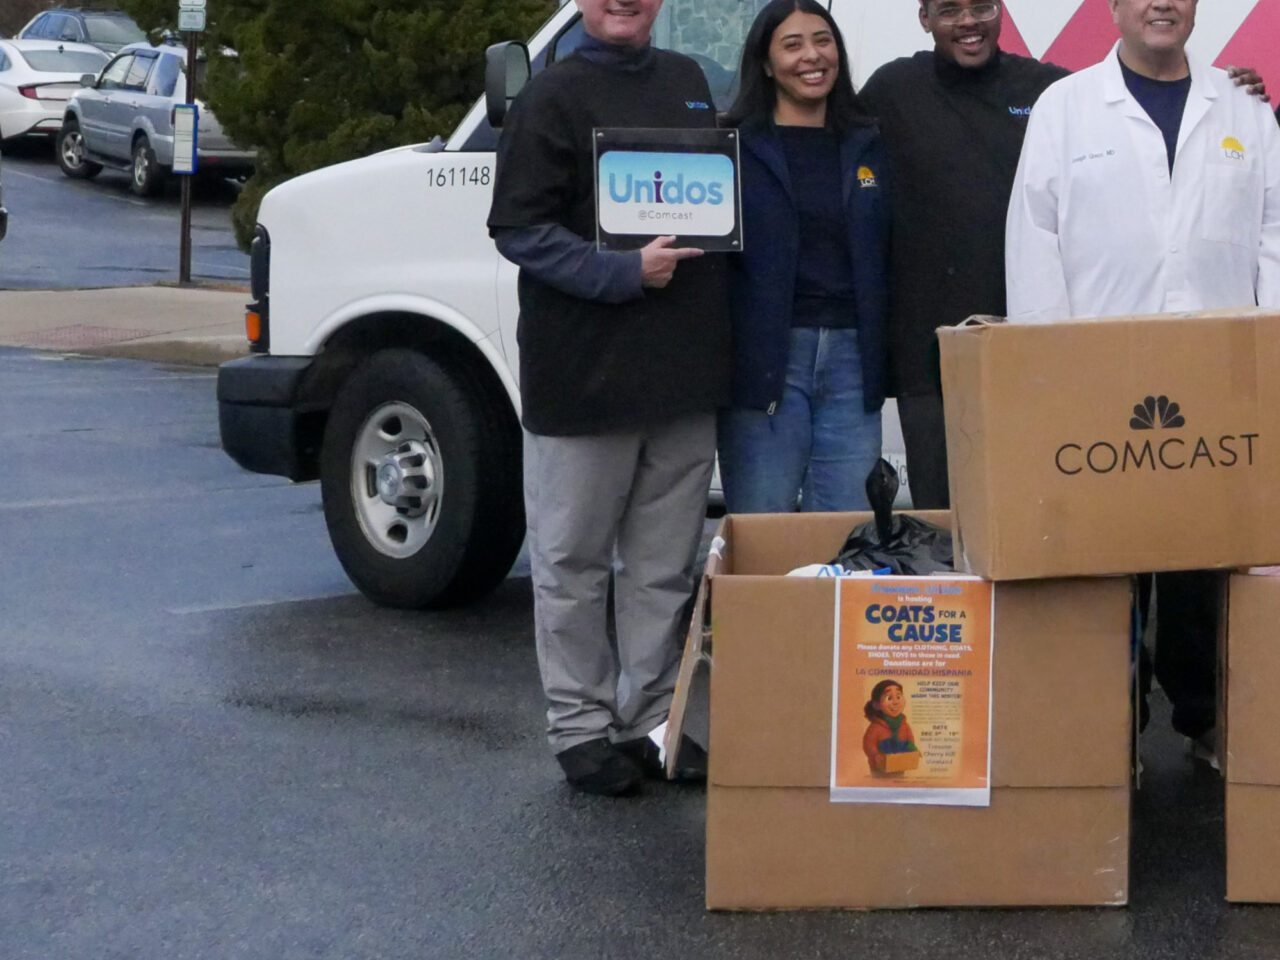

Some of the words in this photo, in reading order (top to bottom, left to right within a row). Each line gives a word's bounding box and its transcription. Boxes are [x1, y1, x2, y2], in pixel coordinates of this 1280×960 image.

[427, 166, 490, 187] 161148
[608, 170, 724, 205] Unidos
[638, 209, 693, 221] @Comcast
[1055, 433, 1259, 475] COMCAST
[865, 604, 935, 624] COATS
[939, 610, 956, 618] FOR
[960, 610, 966, 618] A
[888, 623, 962, 642] CAUSE
[883, 659, 921, 667] Donations
